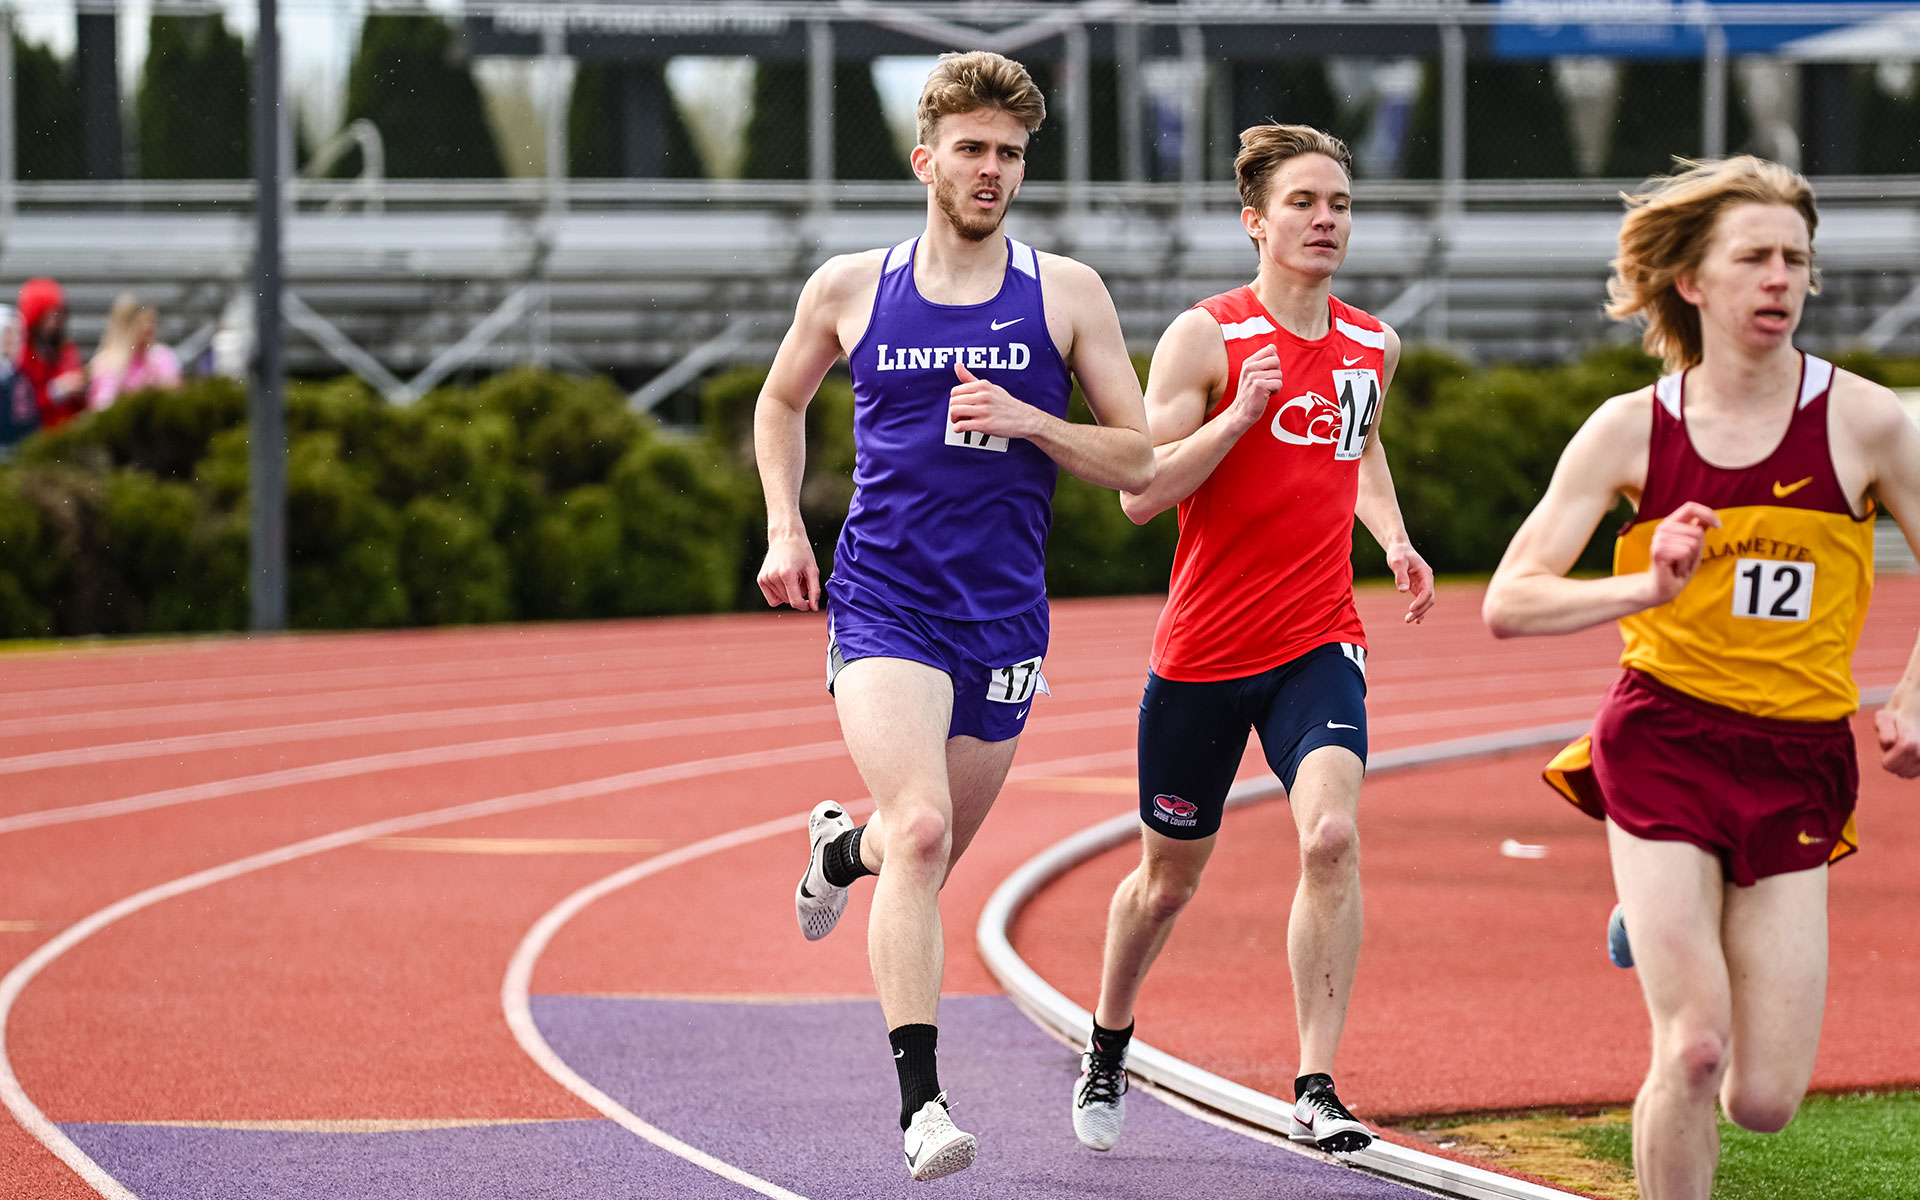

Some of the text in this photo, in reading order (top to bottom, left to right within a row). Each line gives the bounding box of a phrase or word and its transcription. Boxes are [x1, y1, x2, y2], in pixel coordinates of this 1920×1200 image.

[877, 342, 1031, 371] LINFIELD
[1340, 379, 1378, 451] 14
[1701, 537, 1811, 563] LAMETTE
[1742, 563, 1803, 618] 12
[1001, 661, 1036, 701] 17
